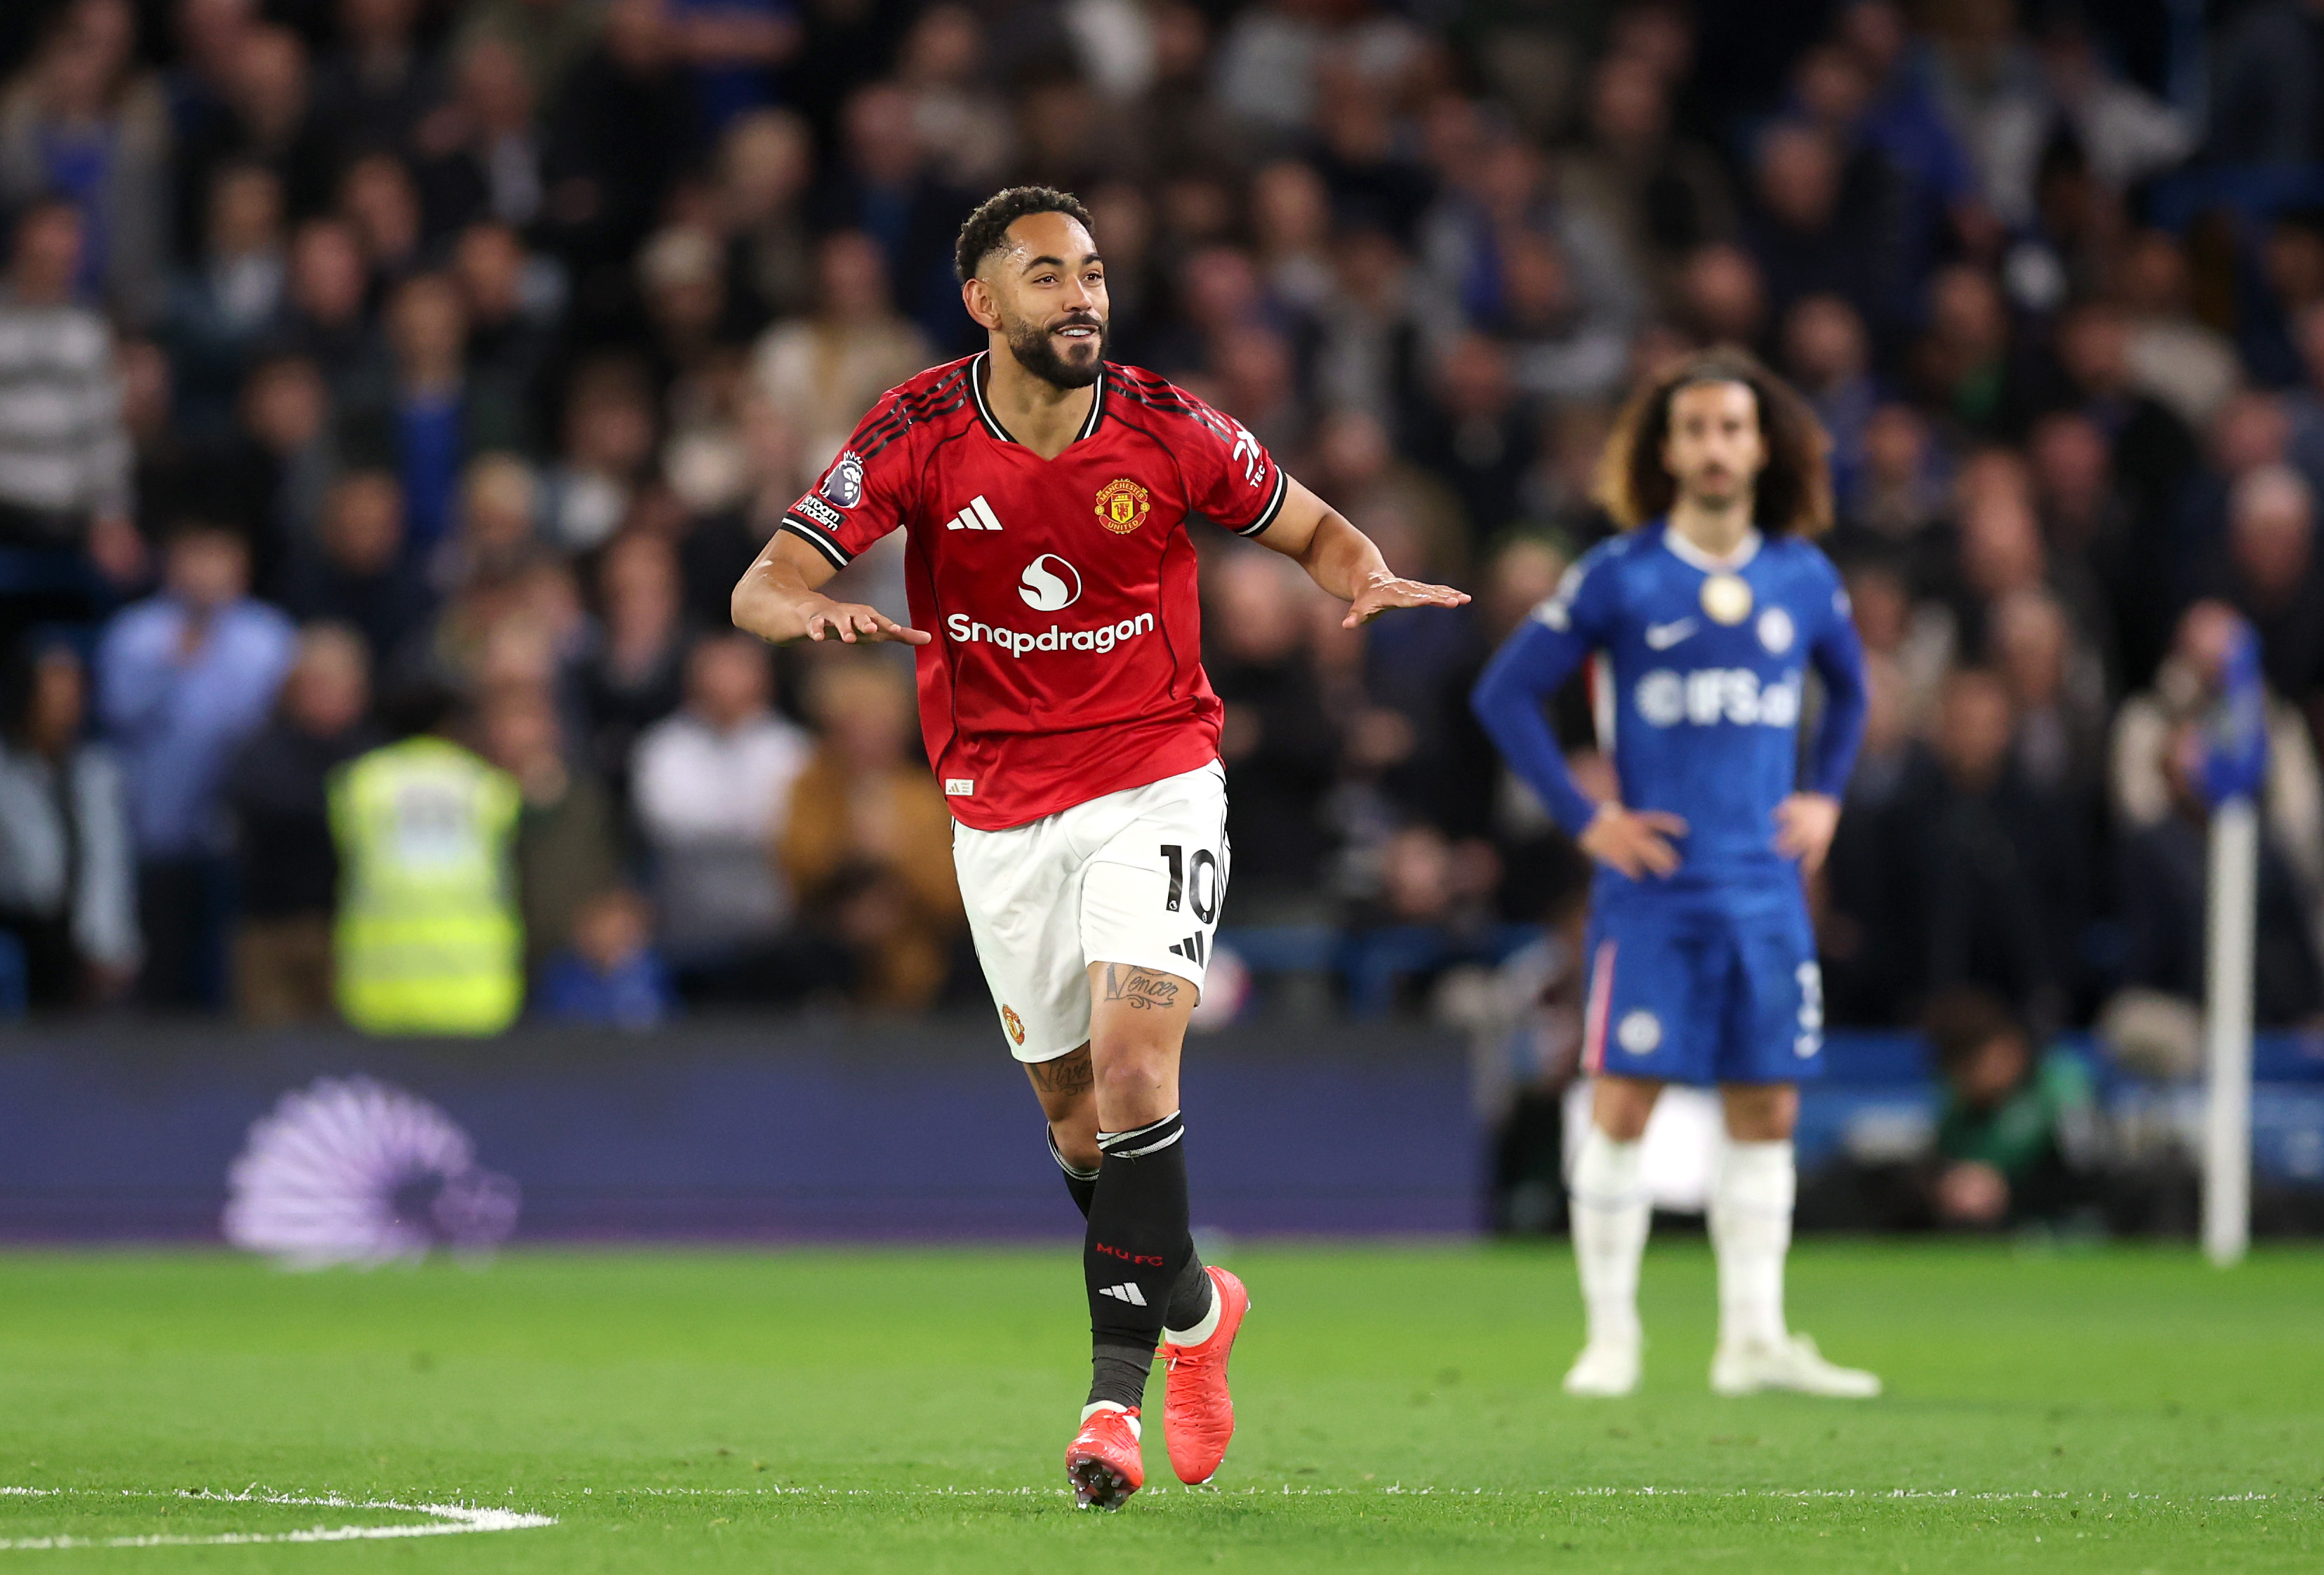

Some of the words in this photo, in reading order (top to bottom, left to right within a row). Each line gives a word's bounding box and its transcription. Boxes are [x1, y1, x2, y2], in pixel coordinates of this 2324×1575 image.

[1249, 460, 1266, 488] TEC
[1099, 482, 1145, 502] MANCHESTER
[804, 505, 839, 531] racism
[809, 498, 839, 523] room
[1108, 519, 1138, 531] UNITED
[948, 612, 1155, 658] Snapdragon
[1160, 844, 1216, 925] 10
